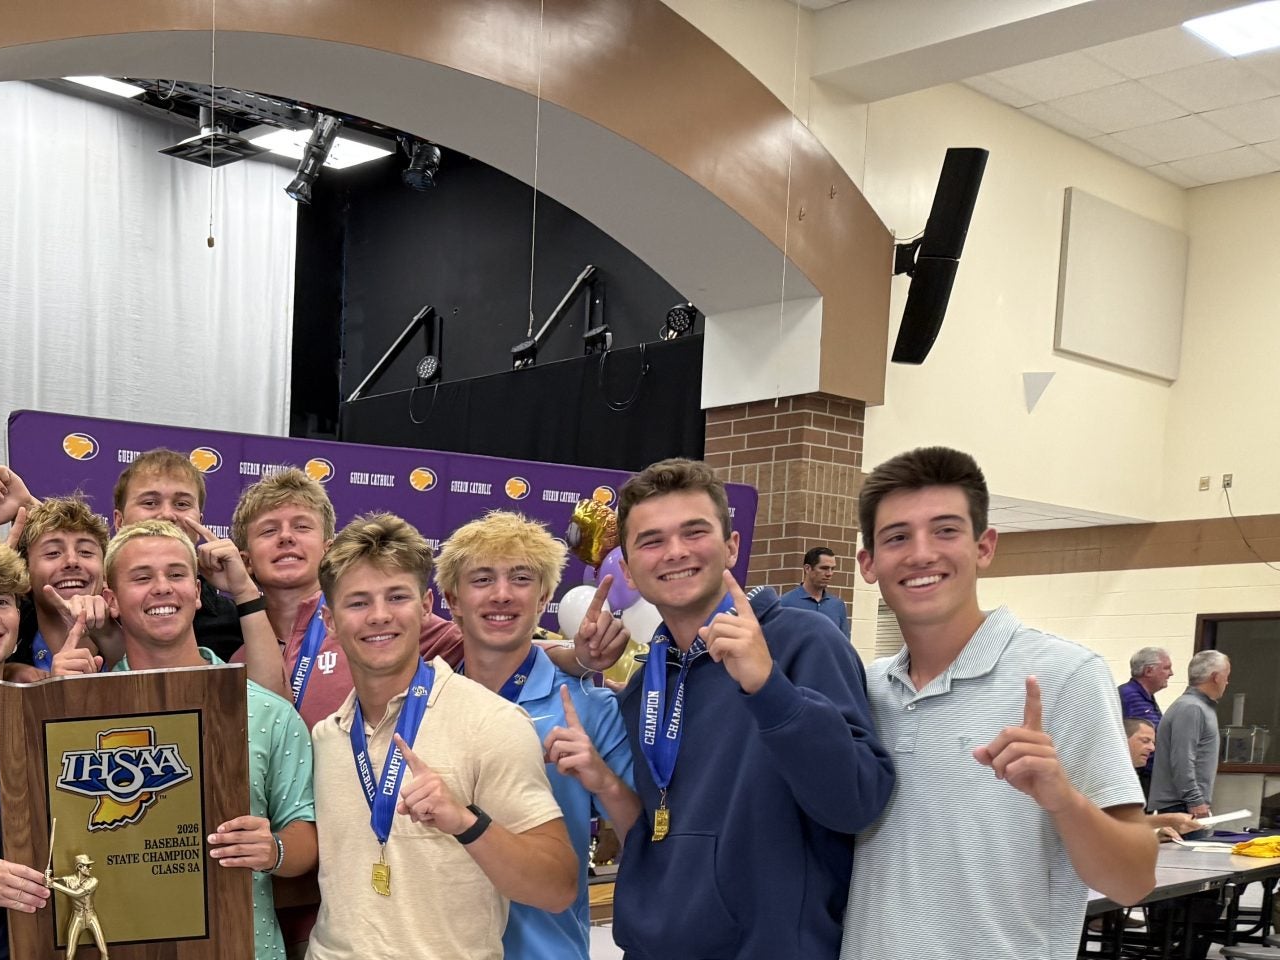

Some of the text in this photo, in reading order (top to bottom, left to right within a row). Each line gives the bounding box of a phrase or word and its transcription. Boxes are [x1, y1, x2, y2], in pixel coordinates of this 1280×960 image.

[239, 462, 260, 476] GUERIN
[350, 472, 395, 487] GUERIN CATHOLIC
[451, 480, 491, 495] GUERIN CATHOLIC
[543, 490, 558, 501] GUERIN
[644, 690, 660, 746] CHAMPION
[666, 682, 685, 740] CHAMPION
[60, 747, 188, 794] IHSAA
[357, 750, 376, 802] BASEBALL
[177, 823, 199, 835] 2026
[144, 836, 200, 850] BASEBALL
[107, 849, 200, 866] STATE CHAMPION
[152, 862, 200, 875] CLASS 3A
